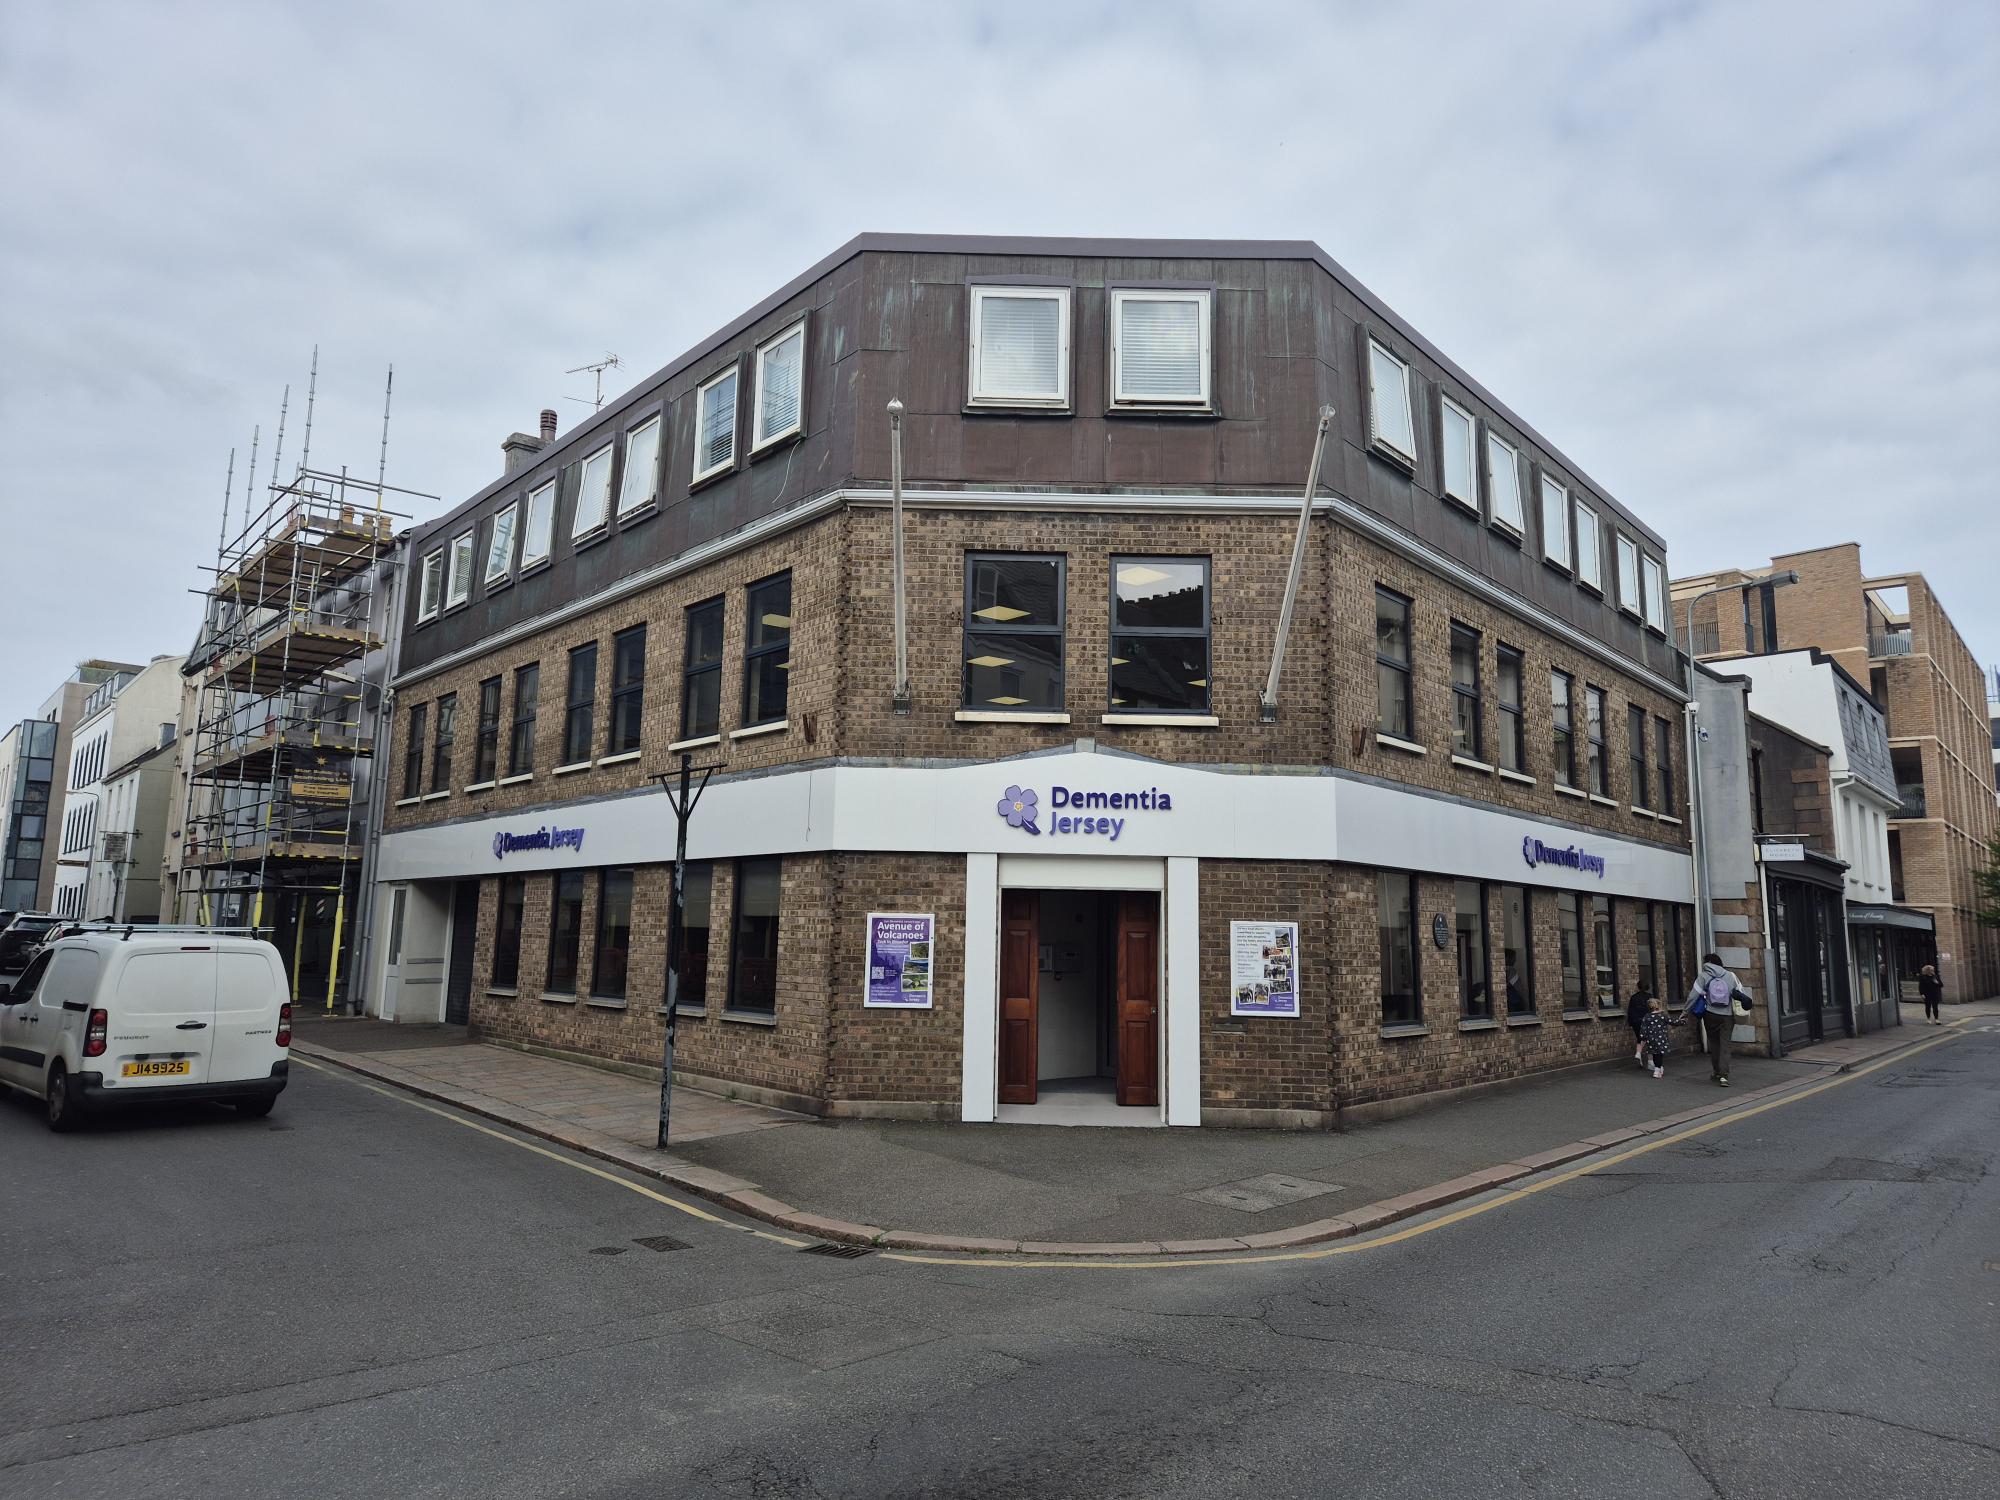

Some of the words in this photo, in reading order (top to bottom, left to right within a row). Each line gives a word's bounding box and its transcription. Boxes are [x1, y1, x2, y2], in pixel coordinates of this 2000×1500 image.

[293, 774, 335, 782] Scaffolding
[1052, 786, 1172, 811] Dementia
[1050, 811, 1125, 841] Jersey
[503, 826, 551, 853] Dementia
[549, 826, 585, 853] Jersey
[1534, 839, 1580, 869] Dementia
[1578, 848, 1605, 880] Jersey
[877, 921, 913, 931] Avenue
[914, 921, 925, 931] of
[877, 930, 924, 940] Volcanoes
[132, 1063, 184, 1075] J149925
